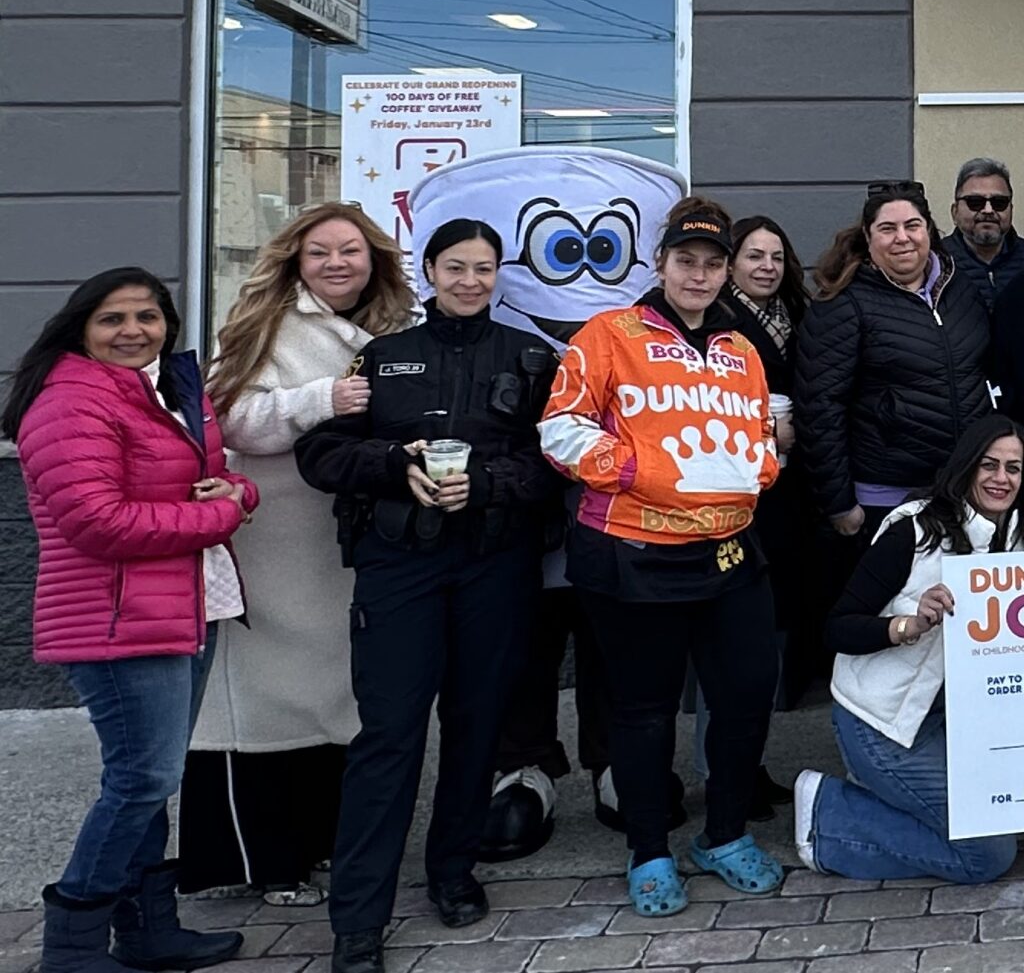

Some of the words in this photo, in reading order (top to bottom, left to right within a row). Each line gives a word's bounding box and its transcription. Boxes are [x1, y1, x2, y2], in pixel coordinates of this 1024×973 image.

[345, 82, 400, 90] CELEBRATE
[402, 81, 423, 89] OUR
[425, 81, 460, 89] GRAND
[461, 81, 518, 89] REOPENING
[386, 93, 406, 101] 100
[408, 93, 435, 101] DAYS
[437, 93, 452, 101] OF
[454, 92, 480, 101] FREE
[428, 104, 482, 113] GIVEAWAY
[371, 119, 411, 130] Friday,
[414, 119, 463, 130] January
[465, 118, 492, 128] 23rd
[971, 647, 980, 656] IN
[987, 676, 1006, 685] PAY
[1008, 675, 1022, 683] TO
[987, 687, 1022, 696] ORDER
[991, 794, 1012, 804] FOR
